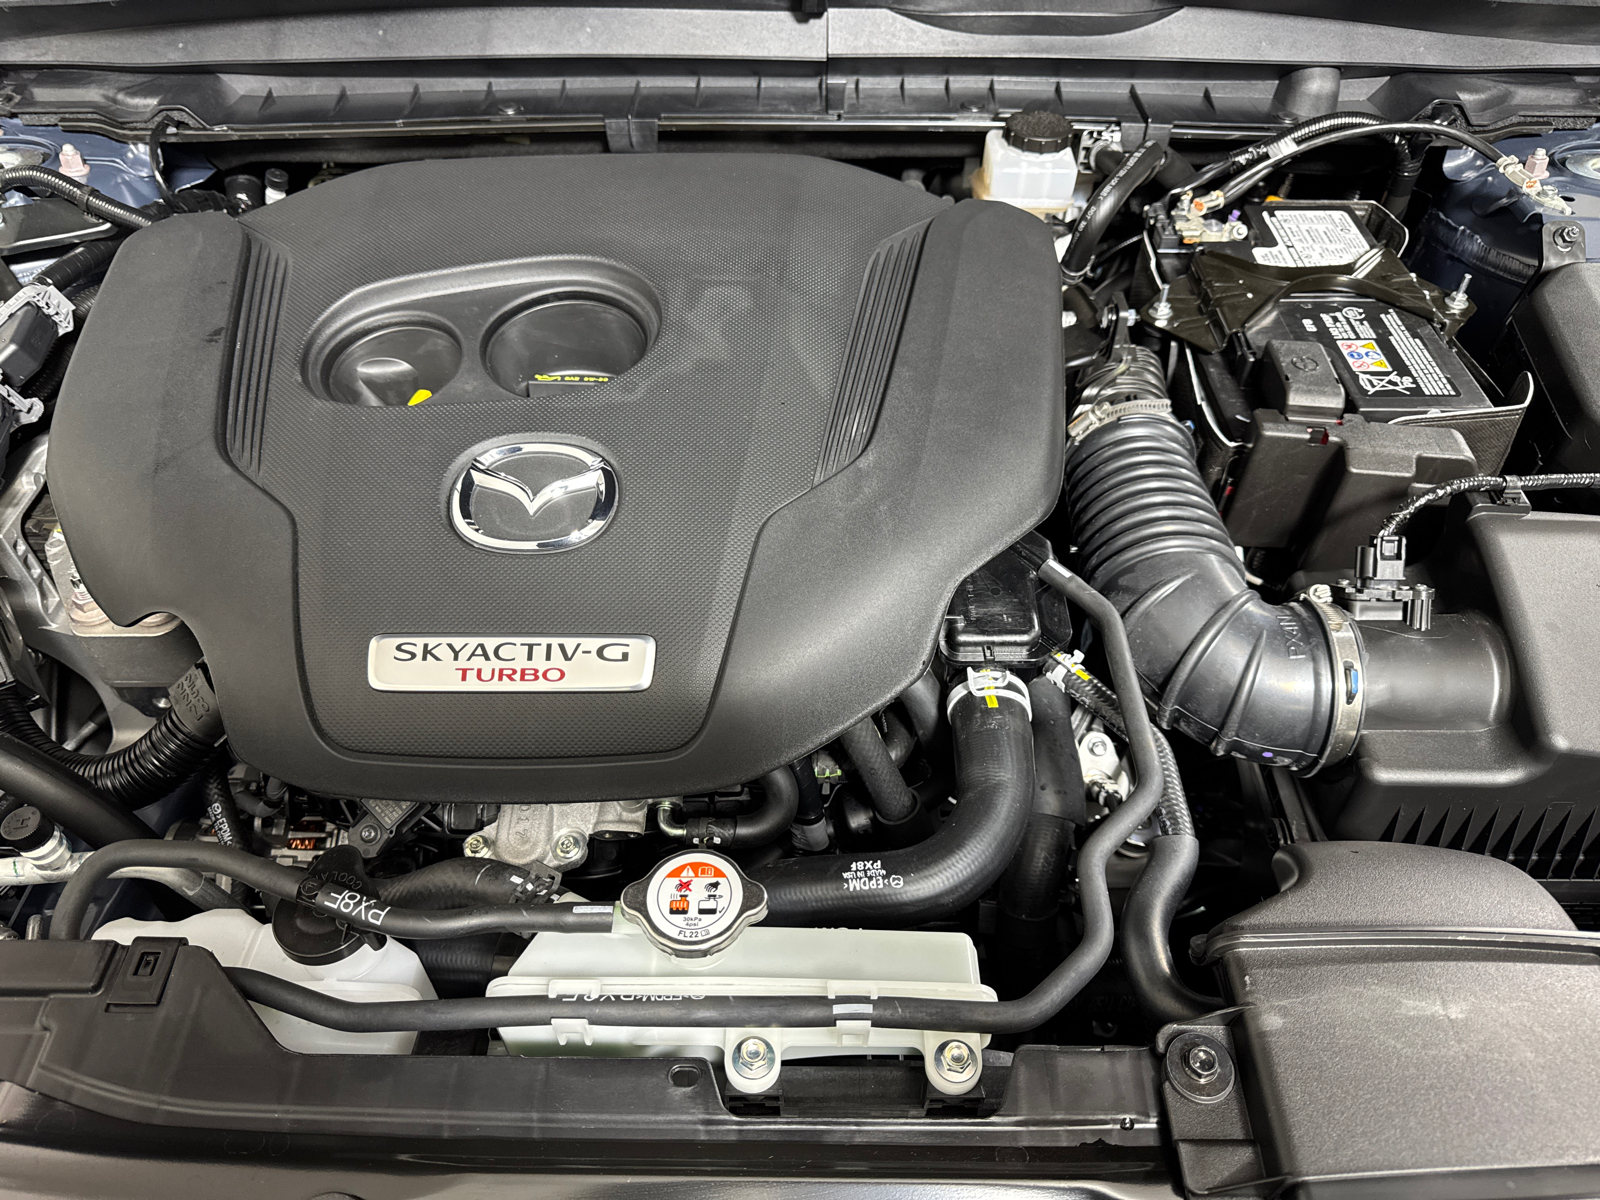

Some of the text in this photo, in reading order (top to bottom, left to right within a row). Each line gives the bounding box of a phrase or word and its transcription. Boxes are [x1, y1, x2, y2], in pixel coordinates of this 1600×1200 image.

[1086, 206, 1097, 220] DOT
[393, 642, 630, 662] SKYACTIV-G
[455, 667, 566, 682] TURBO
[850, 859, 881, 871] PX8F
[842, 869, 886, 879] MADE IN USA
[323, 889, 391, 926] PX8F
[677, 930, 699, 938] FL22
